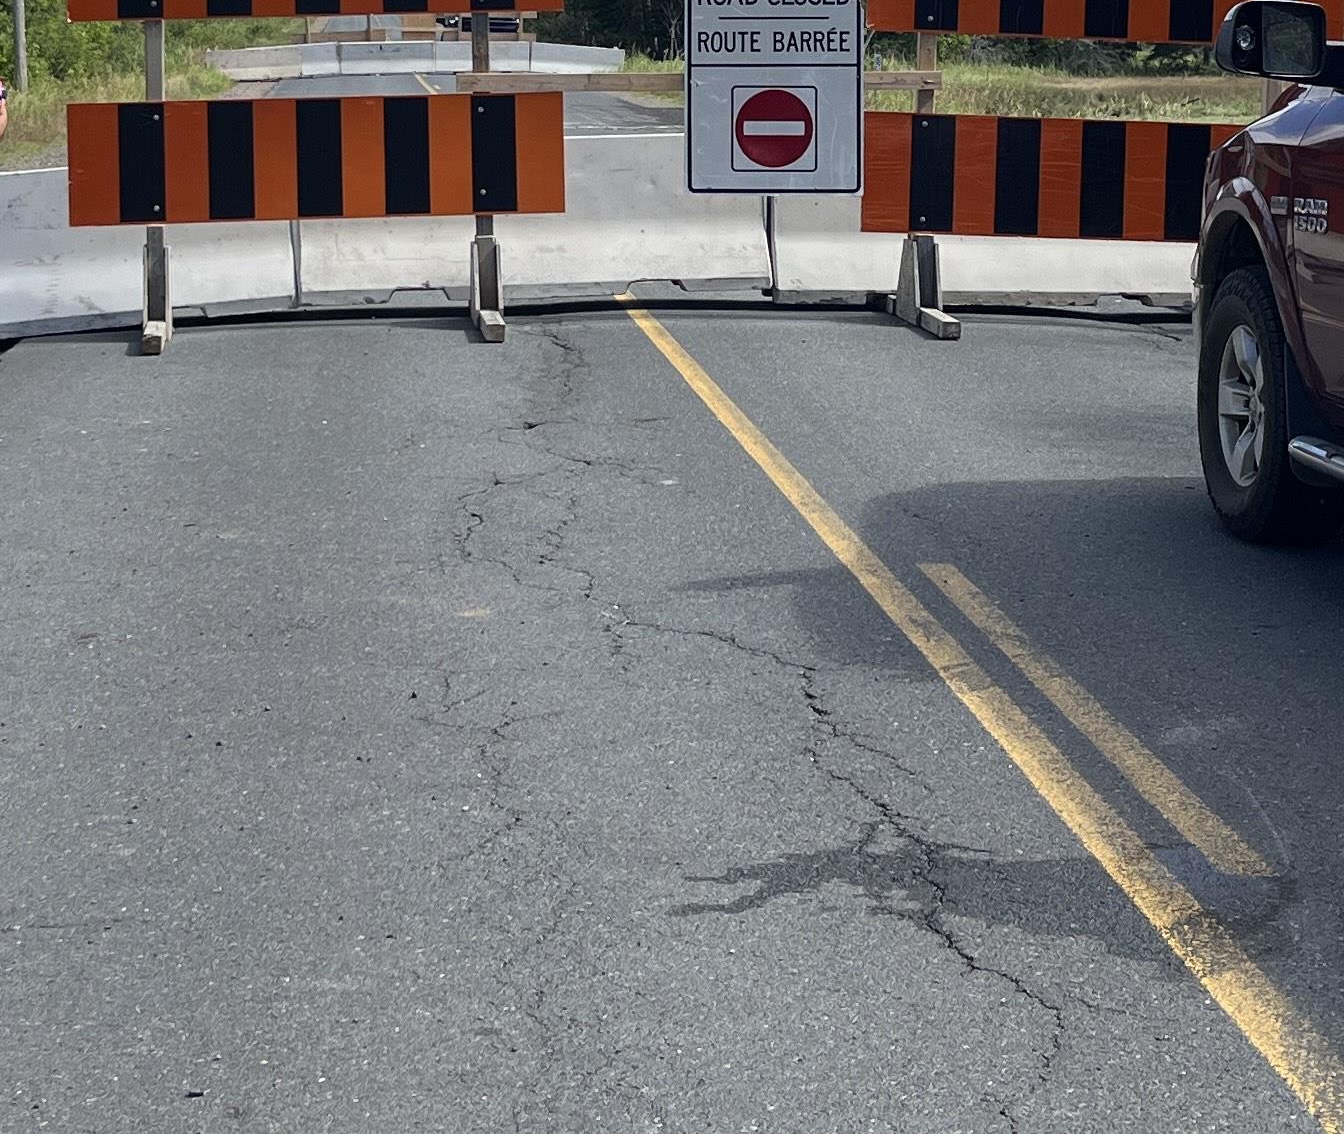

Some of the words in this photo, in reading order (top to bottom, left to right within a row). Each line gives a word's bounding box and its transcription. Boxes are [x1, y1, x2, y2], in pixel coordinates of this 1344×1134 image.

[697, 31, 761, 53] ROUTE
[772, 27, 851, 53] BARRÉE
[1294, 197, 1328, 215] RAM
[1294, 215, 1328, 234] 1500
